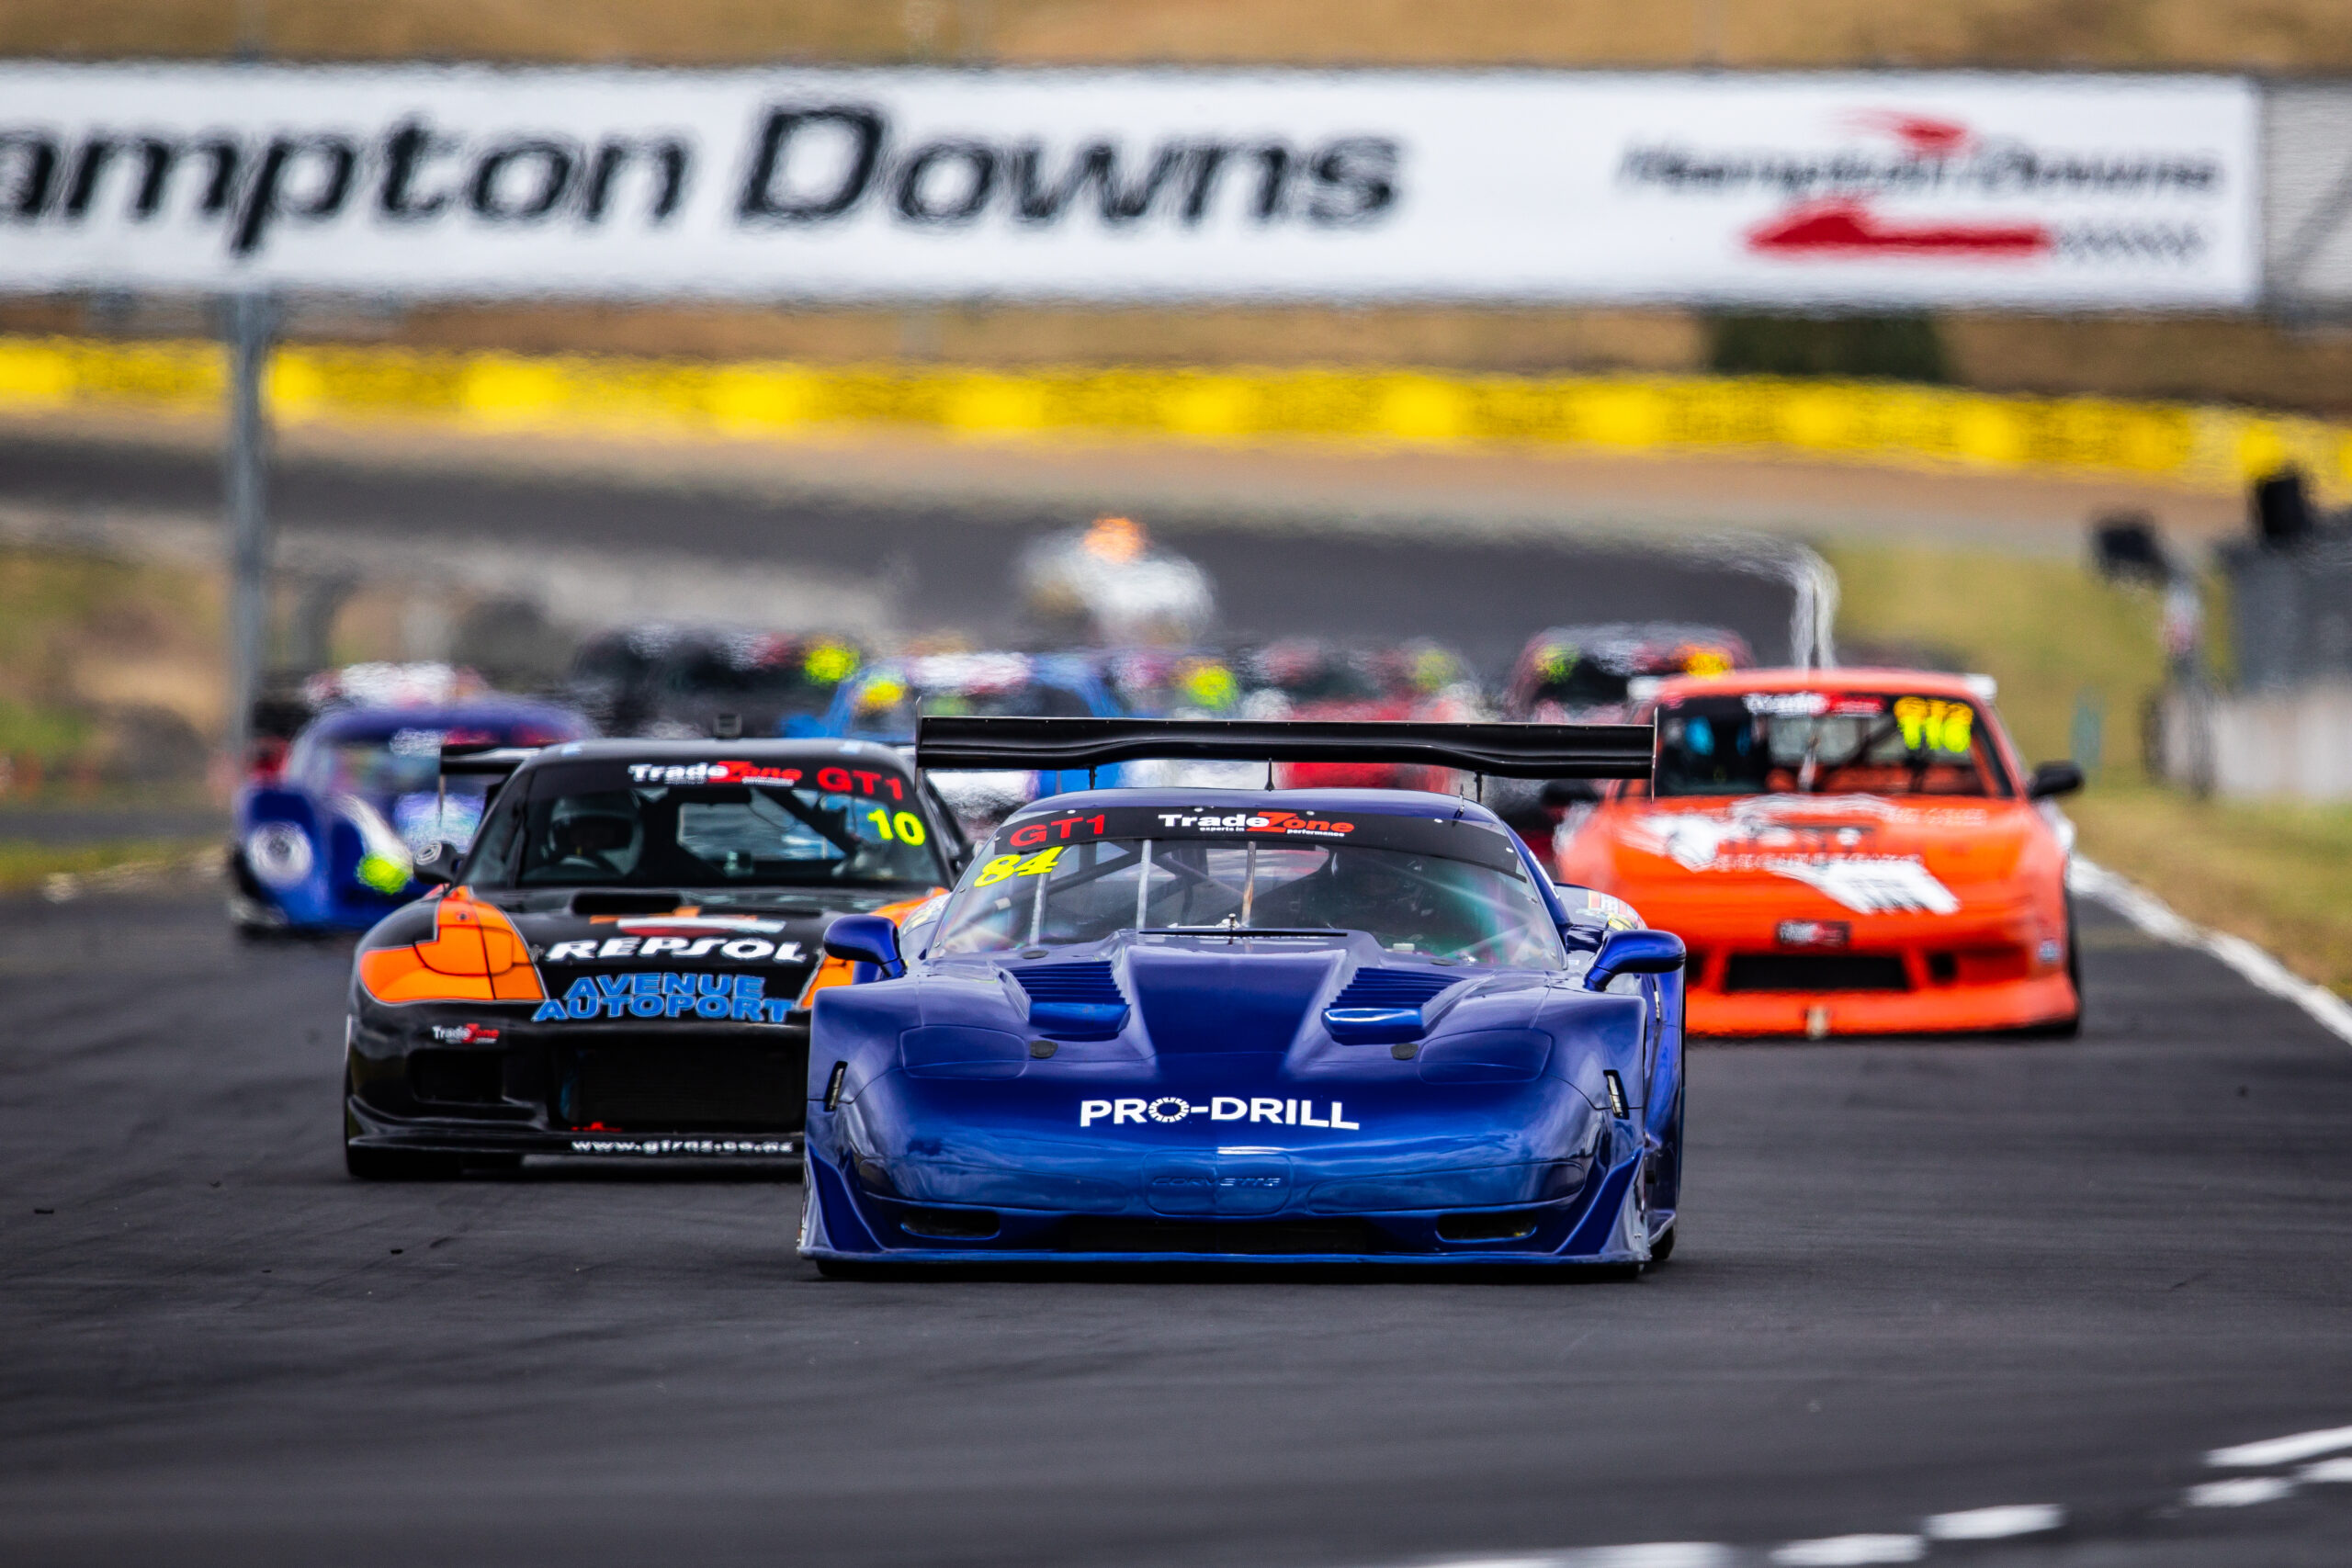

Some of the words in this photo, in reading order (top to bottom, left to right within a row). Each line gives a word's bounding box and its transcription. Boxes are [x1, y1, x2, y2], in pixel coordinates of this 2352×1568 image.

[739, 105, 1402, 225] Downs
[817, 766, 903, 800] GT1
[867, 807, 926, 846] 10
[1010, 814, 1105, 847] GT1
[974, 846, 1064, 887] 84
[545, 937, 807, 963] REPSOL
[565, 972, 766, 999] AVENUE
[530, 995, 796, 1022] AUTOPORT
[1080, 1097, 1360, 1130] PRO-DRILL
